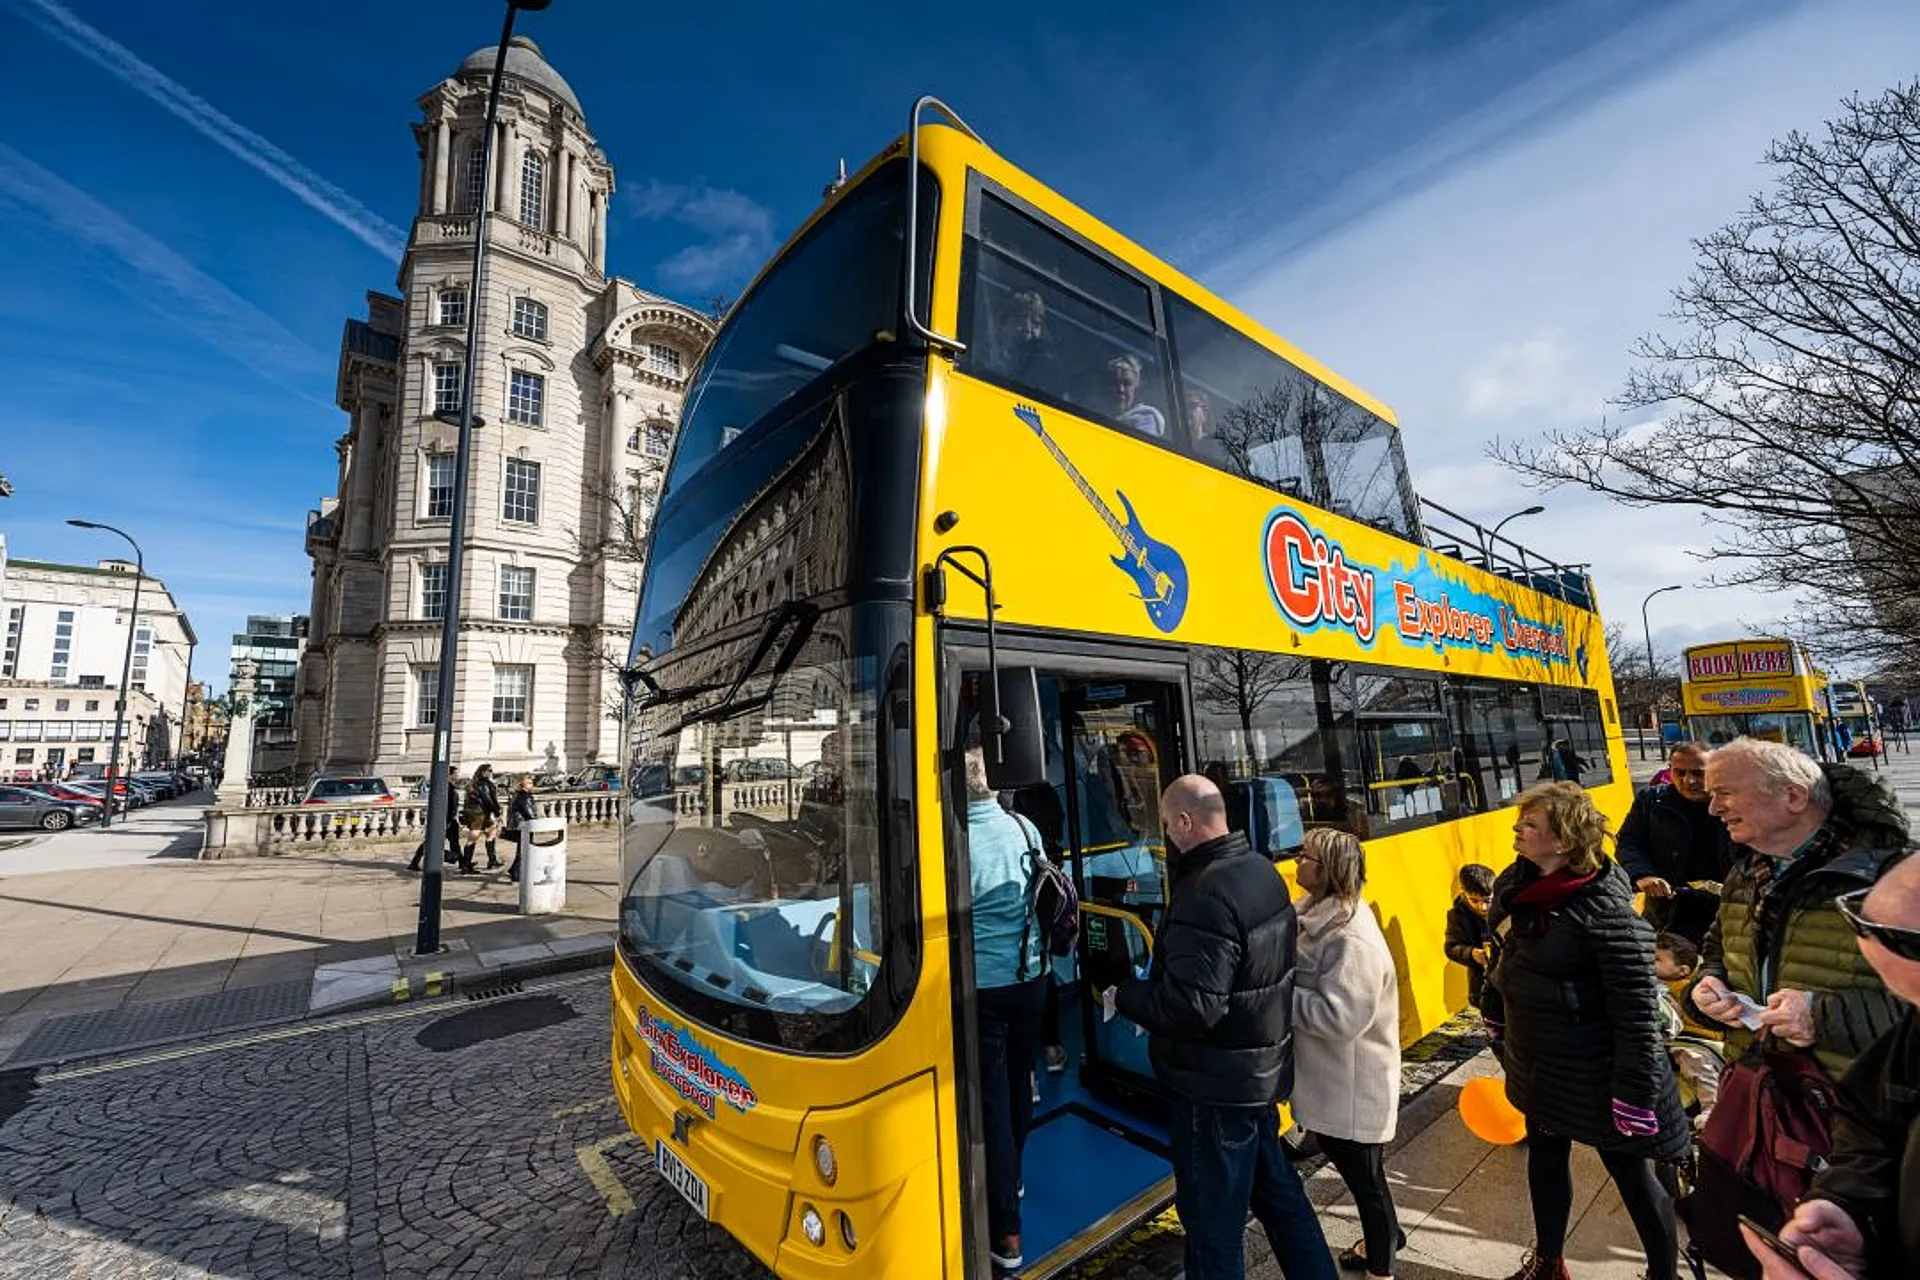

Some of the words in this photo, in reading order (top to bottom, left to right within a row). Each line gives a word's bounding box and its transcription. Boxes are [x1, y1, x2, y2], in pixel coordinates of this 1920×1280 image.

[1266, 514, 1374, 642] City
[1394, 580, 1494, 645] Explorer
[1500, 605, 1568, 660] Liverpool
[1691, 653, 1736, 677] BOOK
[1741, 650, 1789, 673] HERE
[652, 1048, 715, 1117] Liverpool
[666, 1031, 757, 1111] Explorer
